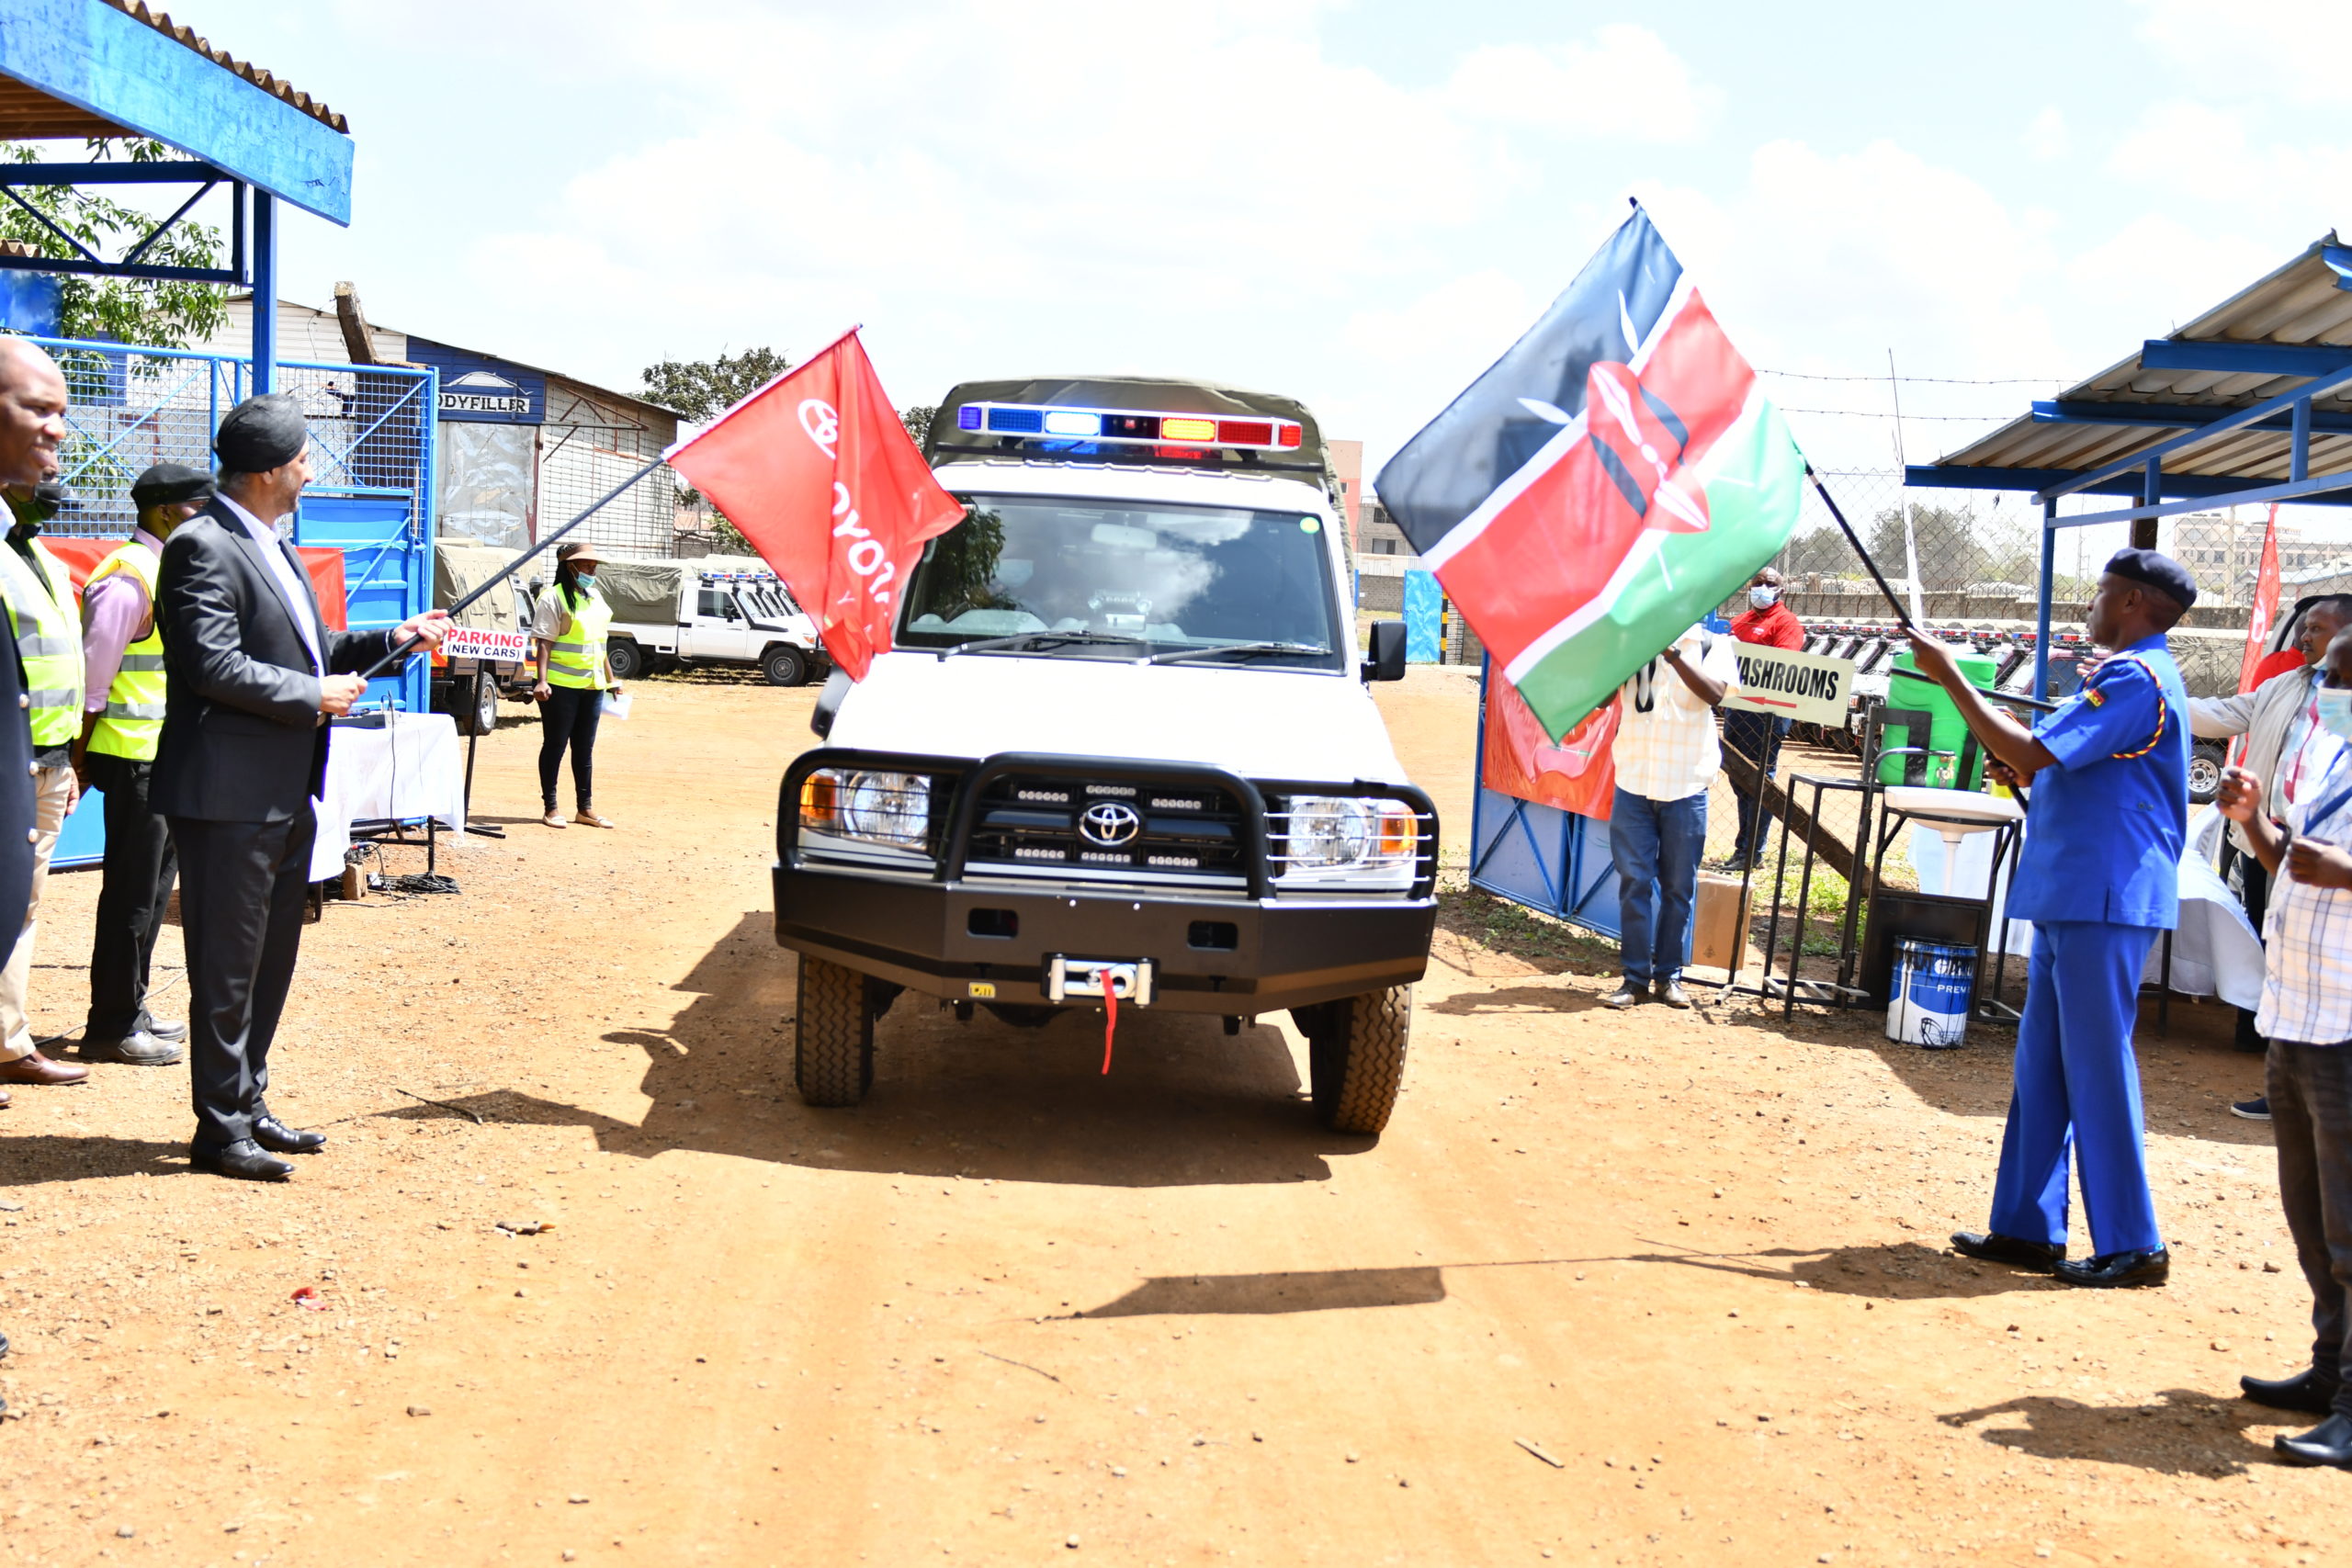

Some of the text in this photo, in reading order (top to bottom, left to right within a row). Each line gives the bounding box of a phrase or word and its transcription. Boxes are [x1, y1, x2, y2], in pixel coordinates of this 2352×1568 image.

[447, 628, 524, 648] PARKING
[447, 644, 520, 660] (NEW CARS)
